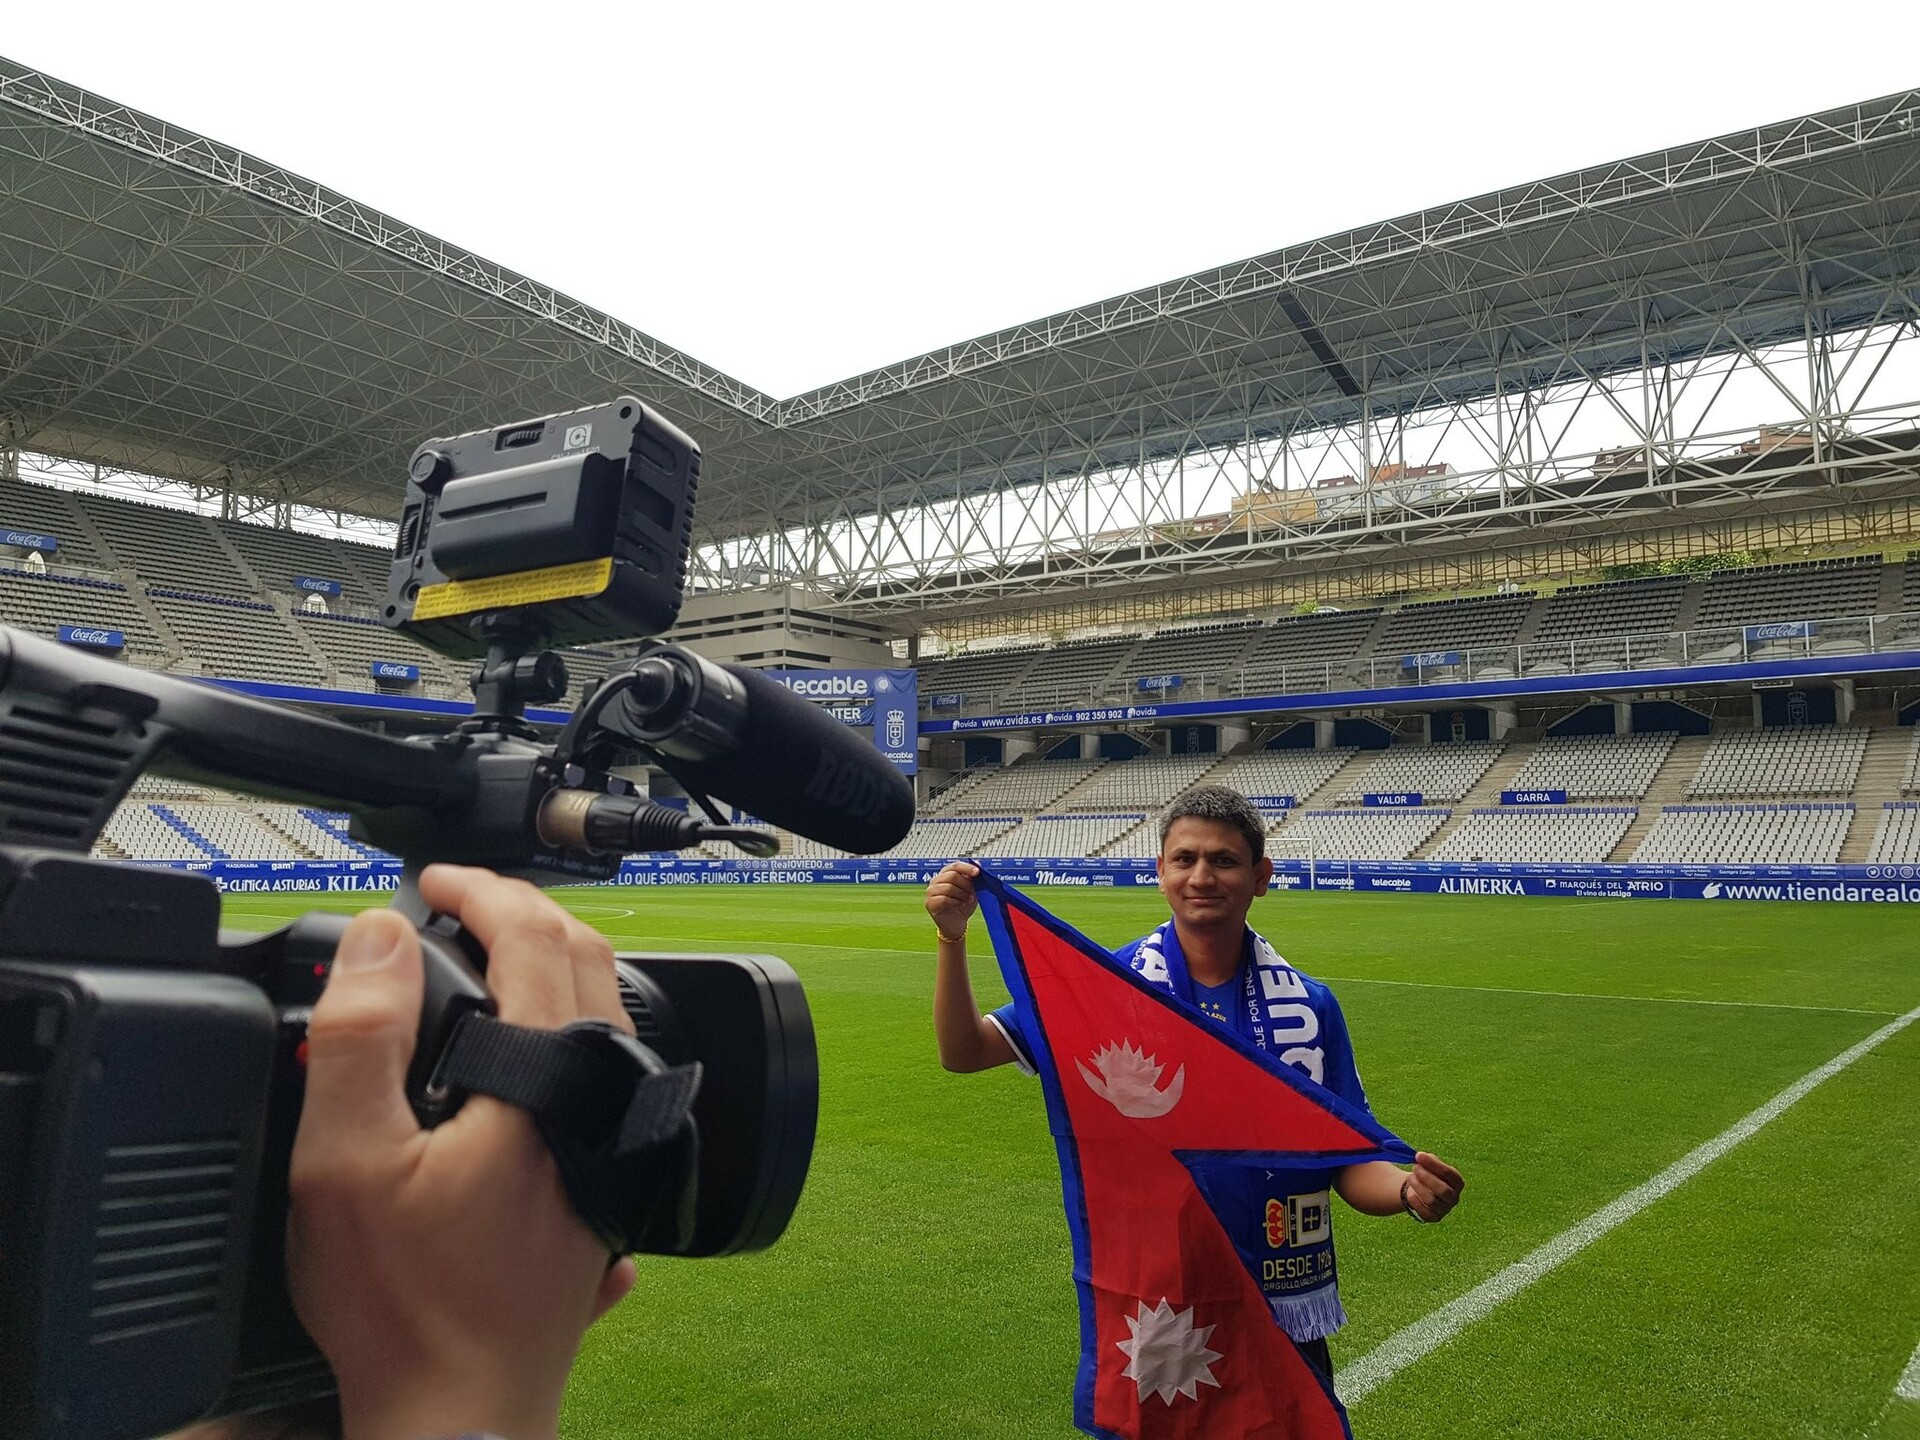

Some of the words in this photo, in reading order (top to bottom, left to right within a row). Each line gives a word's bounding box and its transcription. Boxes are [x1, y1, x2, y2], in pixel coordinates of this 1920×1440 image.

[776, 676, 867, 695] lecable
[823, 707, 861, 719] NTER
[982, 715, 1042, 728] www.ovida.es
[1075, 712, 1090, 721] 902
[1091, 711, 1106, 720] 350
[1107, 710, 1122, 719] 902
[882, 751, 914, 759] lecable
[1377, 795, 1408, 806] VALOR
[1516, 793, 1551, 803] GARRA
[618, 873, 633, 886] LO
[634, 872, 658, 885] QUE
[701, 872, 740, 884] FUIMOS
[742, 871, 751, 884] Y
[752, 871, 814, 883] SEREMOS
[897, 872, 918, 881] INTER
[1035, 870, 1089, 885] Malena
[1317, 877, 1355, 886] telecable
[1371, 878, 1411, 887] telecable
[1438, 878, 1526, 896] ALIMERKA
[1606, 881, 1623, 889] DEL
[1627, 881, 1664, 892] ATRIO
[1248, 999, 1261, 1023] POR
[1263, 1254, 1313, 1281] DESDE
